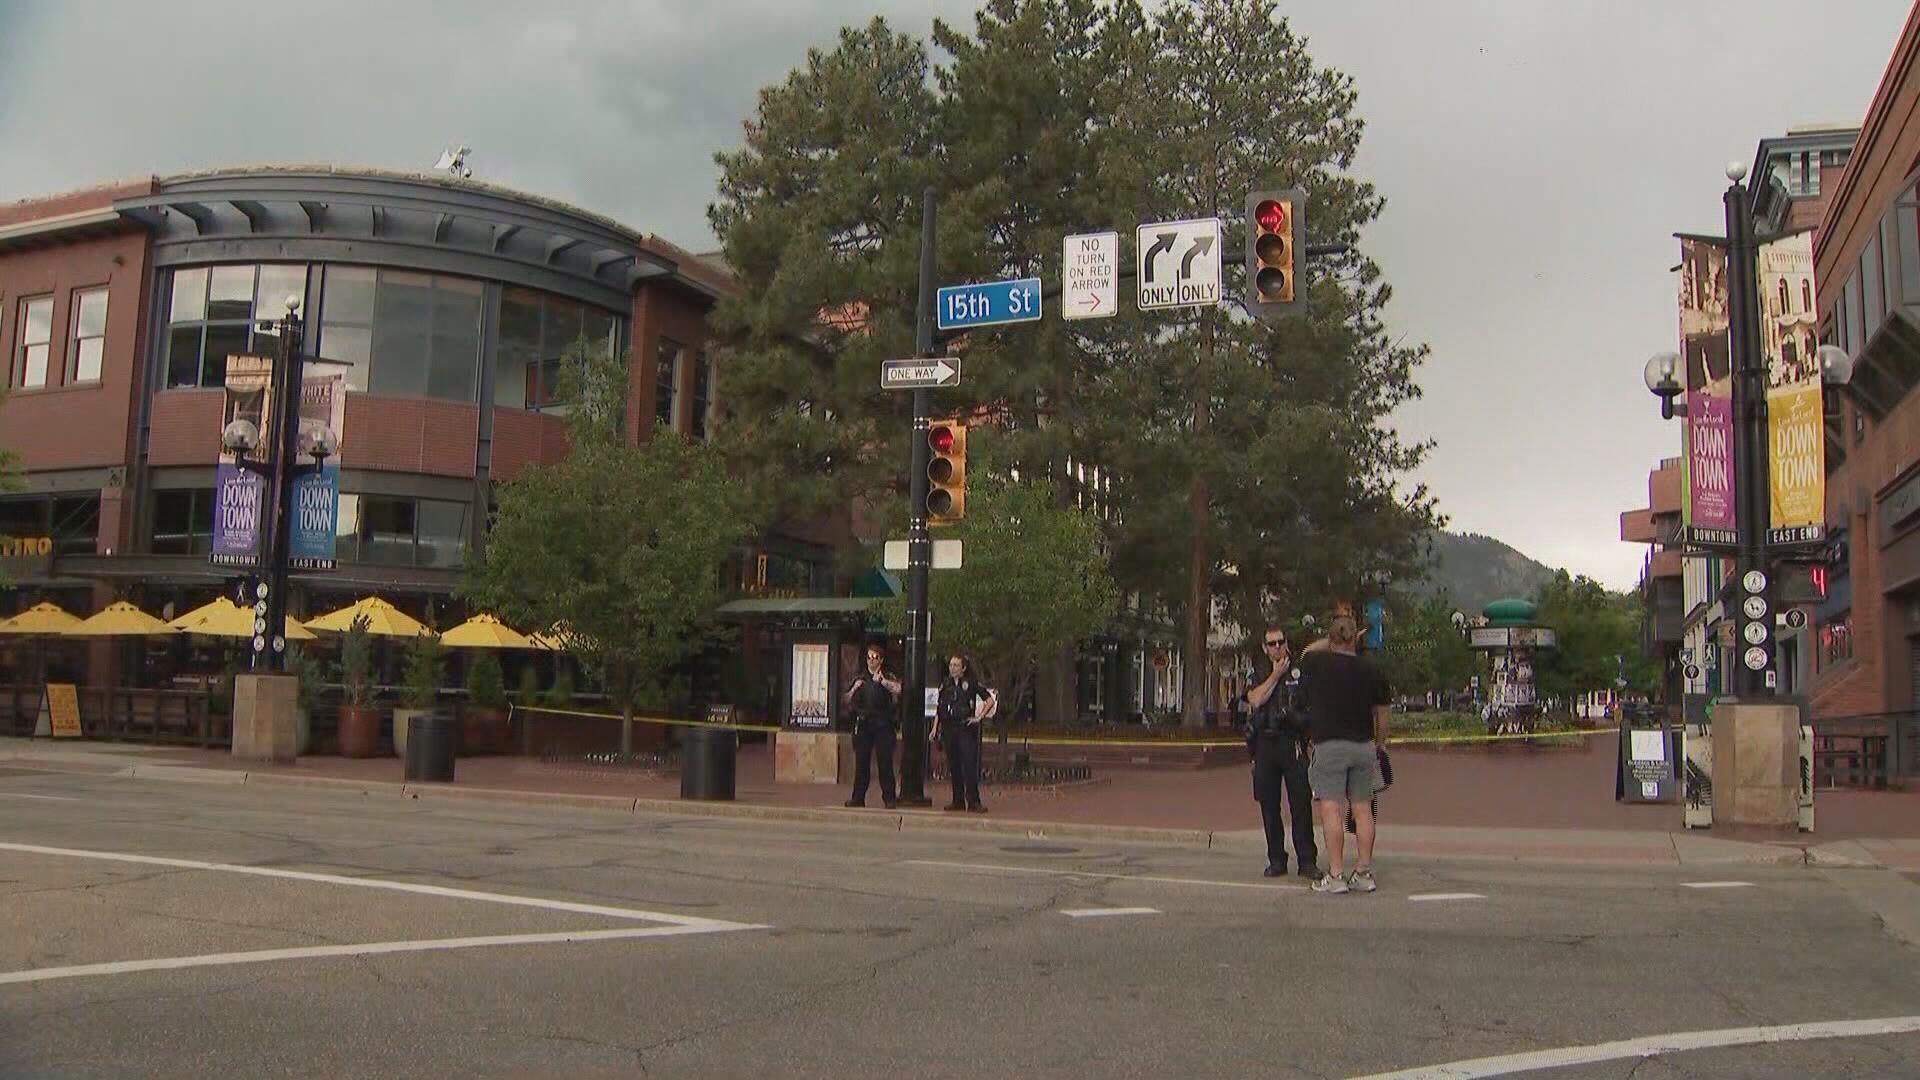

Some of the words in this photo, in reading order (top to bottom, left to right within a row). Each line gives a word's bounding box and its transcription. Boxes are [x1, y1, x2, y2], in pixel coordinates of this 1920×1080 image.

[1081, 238, 1100, 252] NO
[1077, 253, 1105, 265] TURN
[1069, 267, 1084, 278] ON
[1090, 265, 1111, 277] RED
[1071, 278, 1110, 291] ARROW
[1142, 286, 1175, 304] ONLY
[1182, 282, 1216, 301] ONLY
[947, 292, 990, 320] 15th
[1008, 287, 1032, 314] St
[890, 368, 911, 379] ONE
[914, 367, 936, 379] WAY
[1693, 424, 1727, 459] DOWN
[1776, 422, 1817, 459] DOWN
[1694, 456, 1729, 491] TOWN
[1776, 454, 1818, 492] TOWN
[222, 485, 256, 507] DOWN
[299, 487, 333, 508] DOWN
[221, 506, 256, 530] TOWN
[299, 508, 332, 531] TOWN
[1694, 528, 1736, 544] DOWNTOWN
[1773, 528, 1796, 543] EAST
[1799, 526, 1819, 540] END
[213, 554, 257, 566] DOWNTOWN
[293, 559, 313, 568] EAST
[316, 560, 333, 569] END
[1811, 567, 1826, 597] 4
